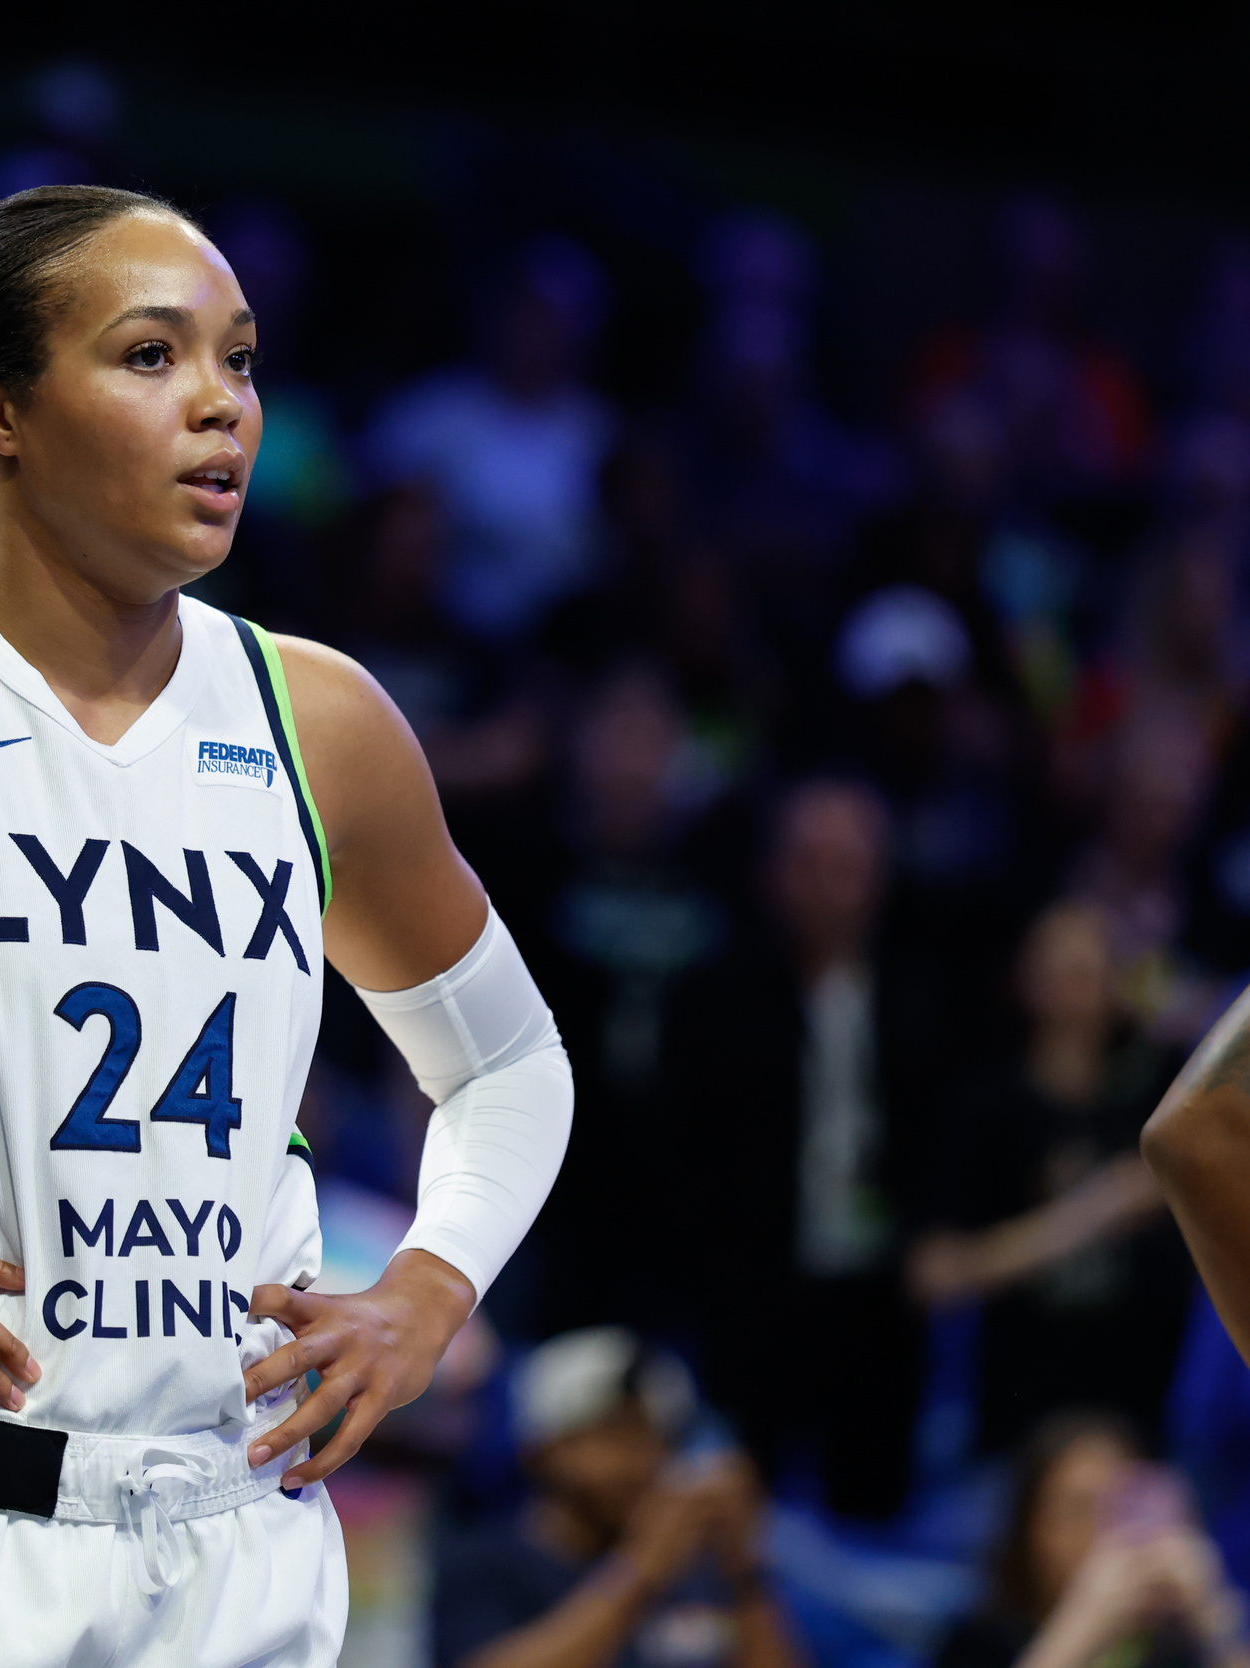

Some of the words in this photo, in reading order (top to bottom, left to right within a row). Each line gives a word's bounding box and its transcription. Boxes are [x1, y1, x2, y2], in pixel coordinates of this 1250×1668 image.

[197, 759, 262, 779] INSURANCE
[50, 980, 243, 1160] 24
[58, 1198, 242, 1263] MAYO
